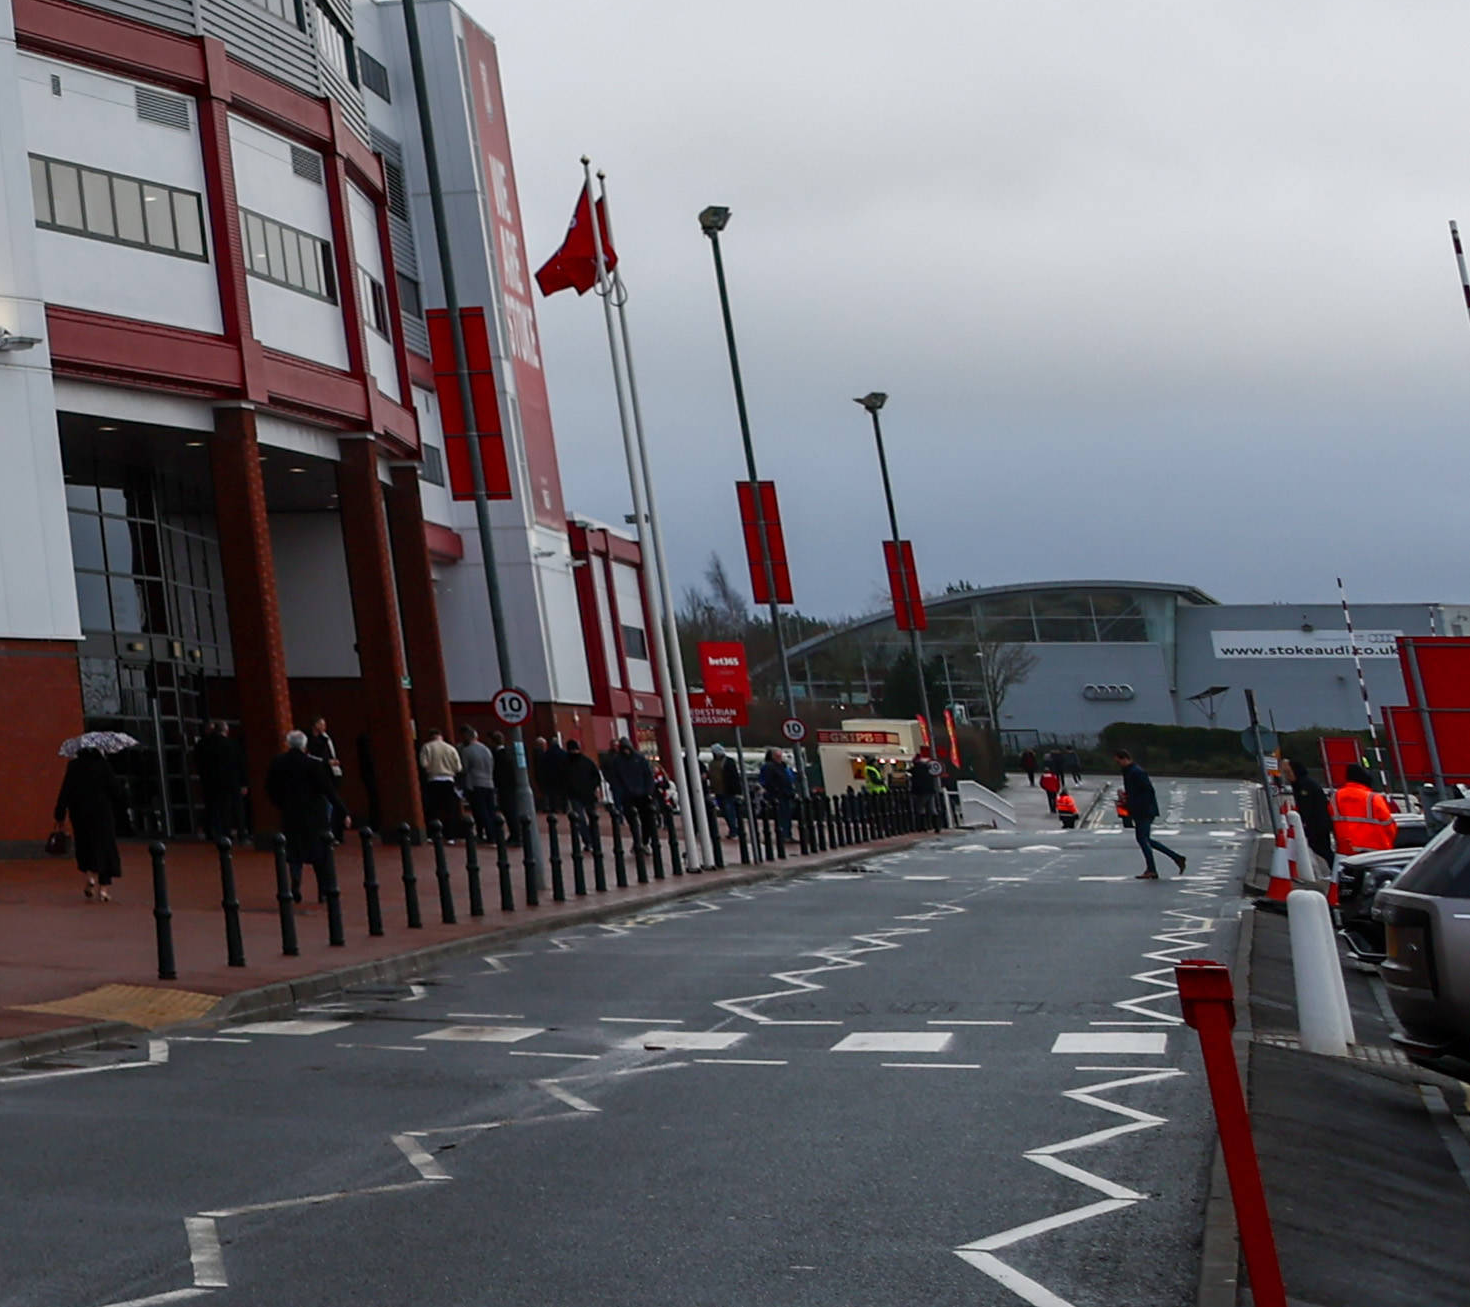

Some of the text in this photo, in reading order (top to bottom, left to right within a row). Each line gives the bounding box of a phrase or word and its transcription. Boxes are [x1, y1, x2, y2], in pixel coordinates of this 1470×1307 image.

[499, 697, 522, 712] 10
[690, 708, 737, 716] EDESTRIAN
[786, 723, 801, 734] 10
